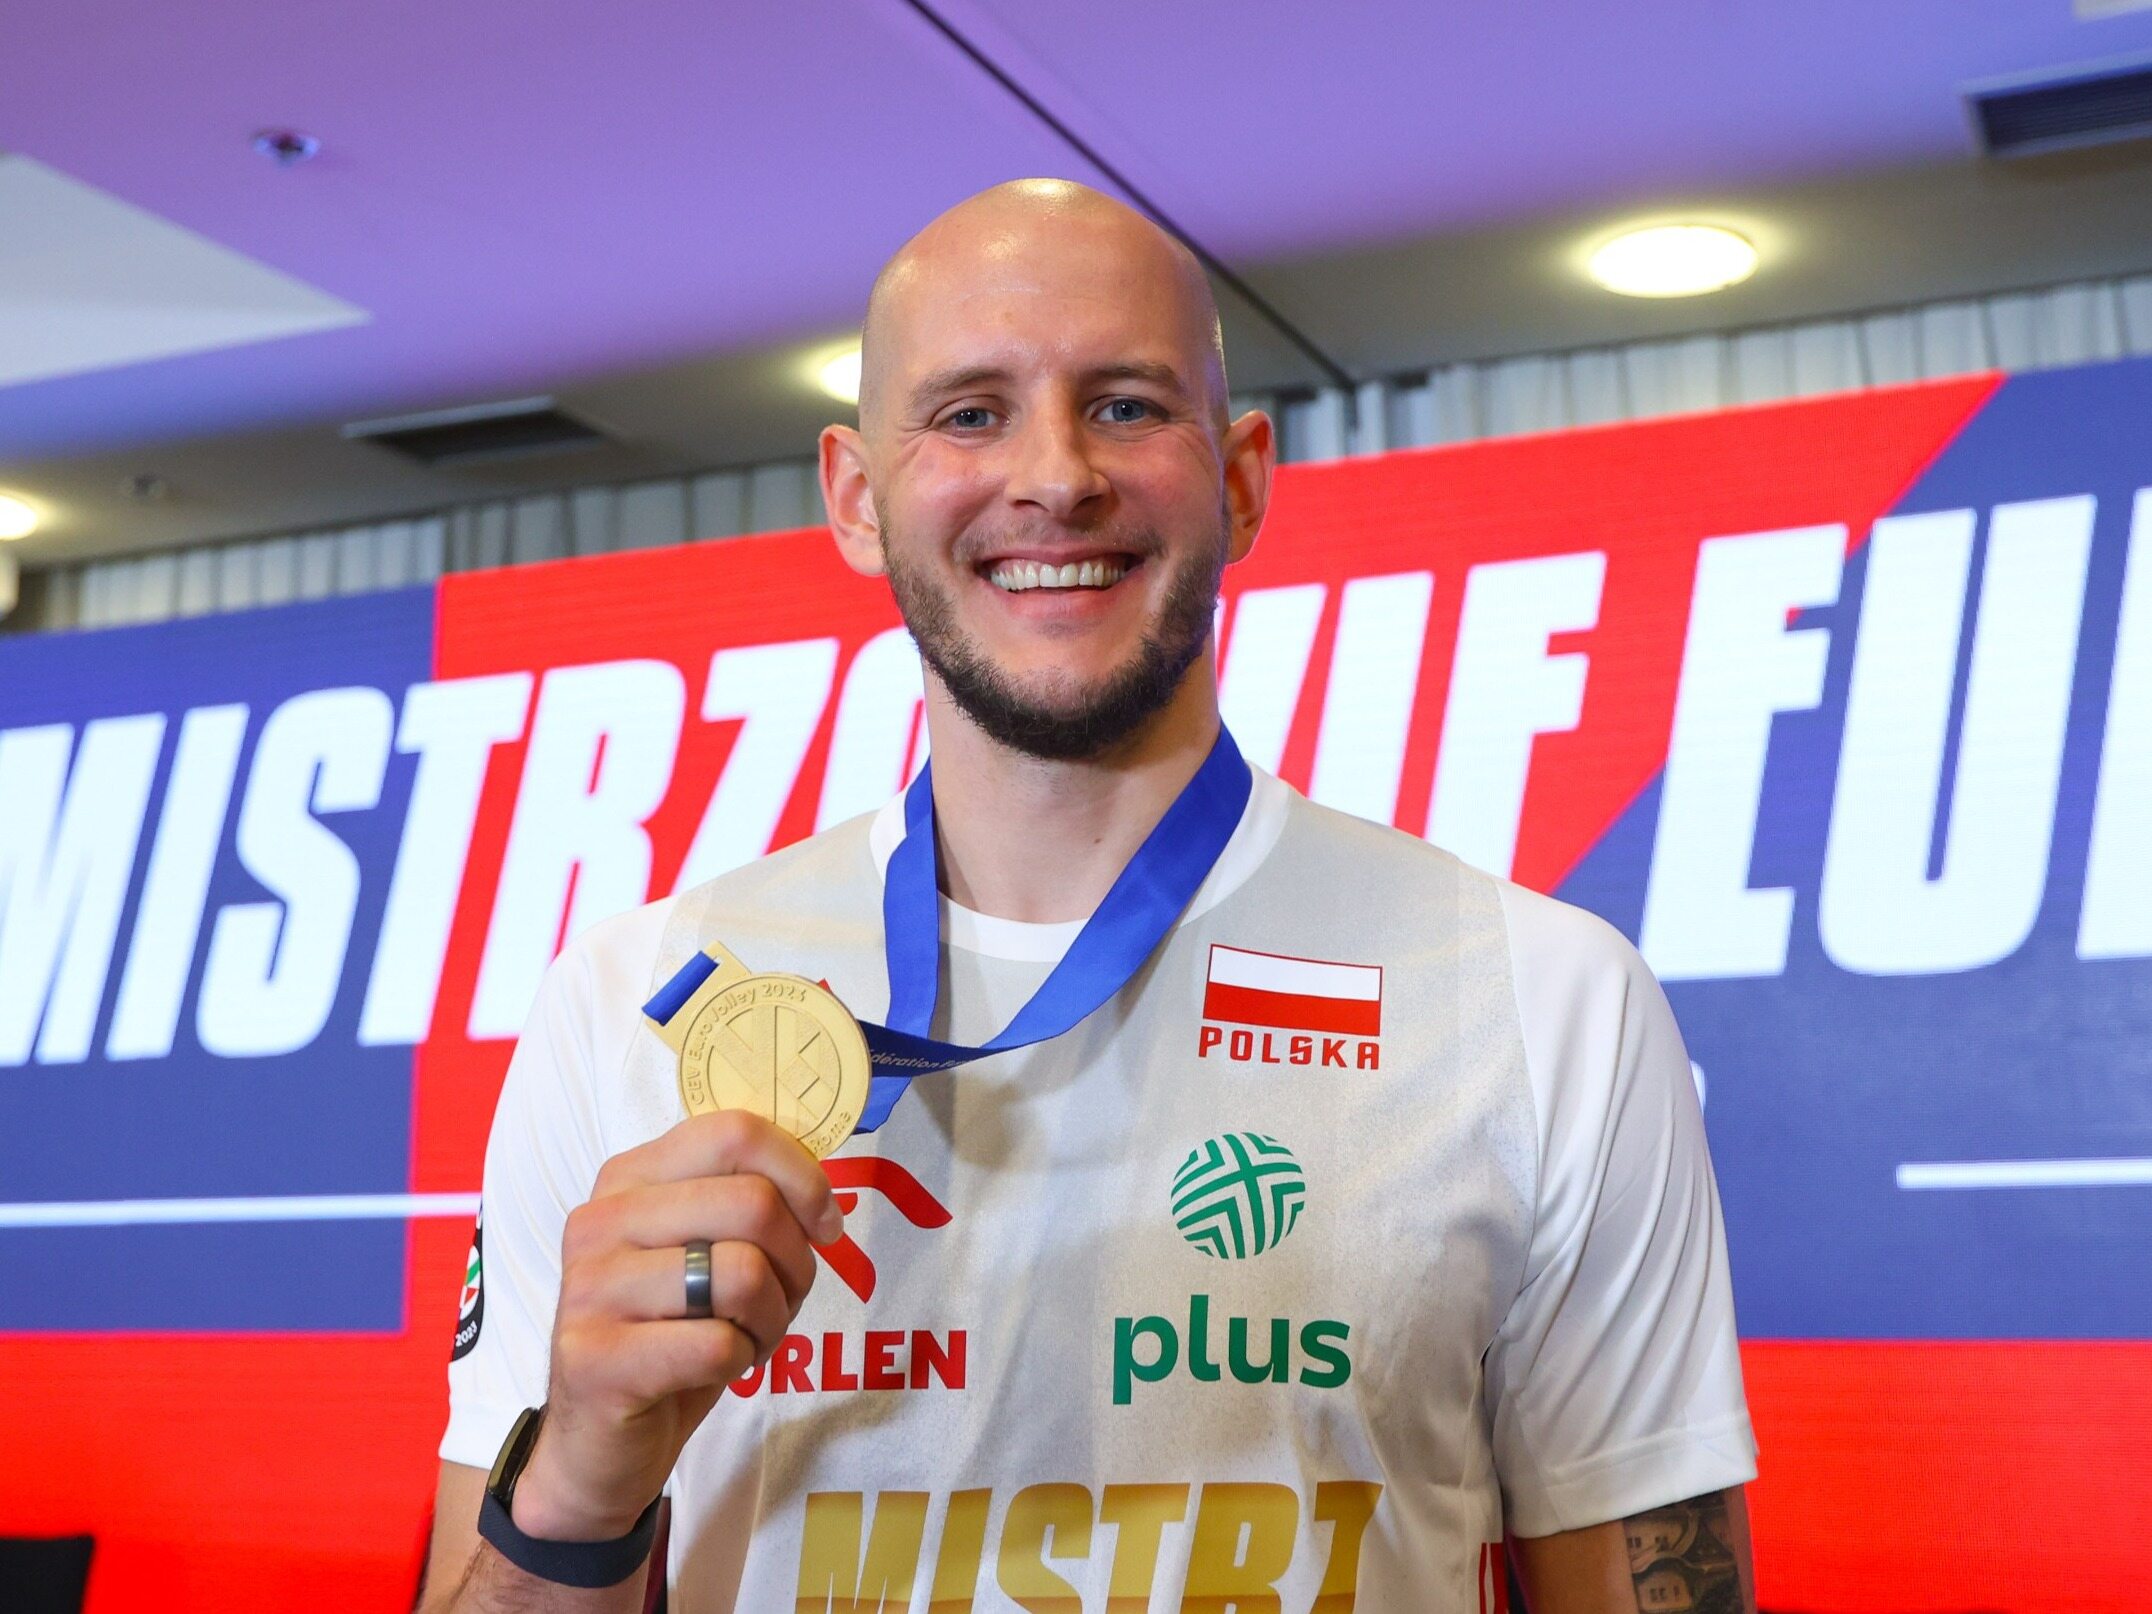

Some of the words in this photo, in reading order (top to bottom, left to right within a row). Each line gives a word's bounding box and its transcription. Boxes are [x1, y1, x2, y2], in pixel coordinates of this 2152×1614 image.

[0, 551, 1607, 1067] MISTRZIE
[871, 1049, 939, 1069] dération
[1199, 1026, 1380, 1070] POLSKA
[1113, 1295, 1351, 1405] plus
